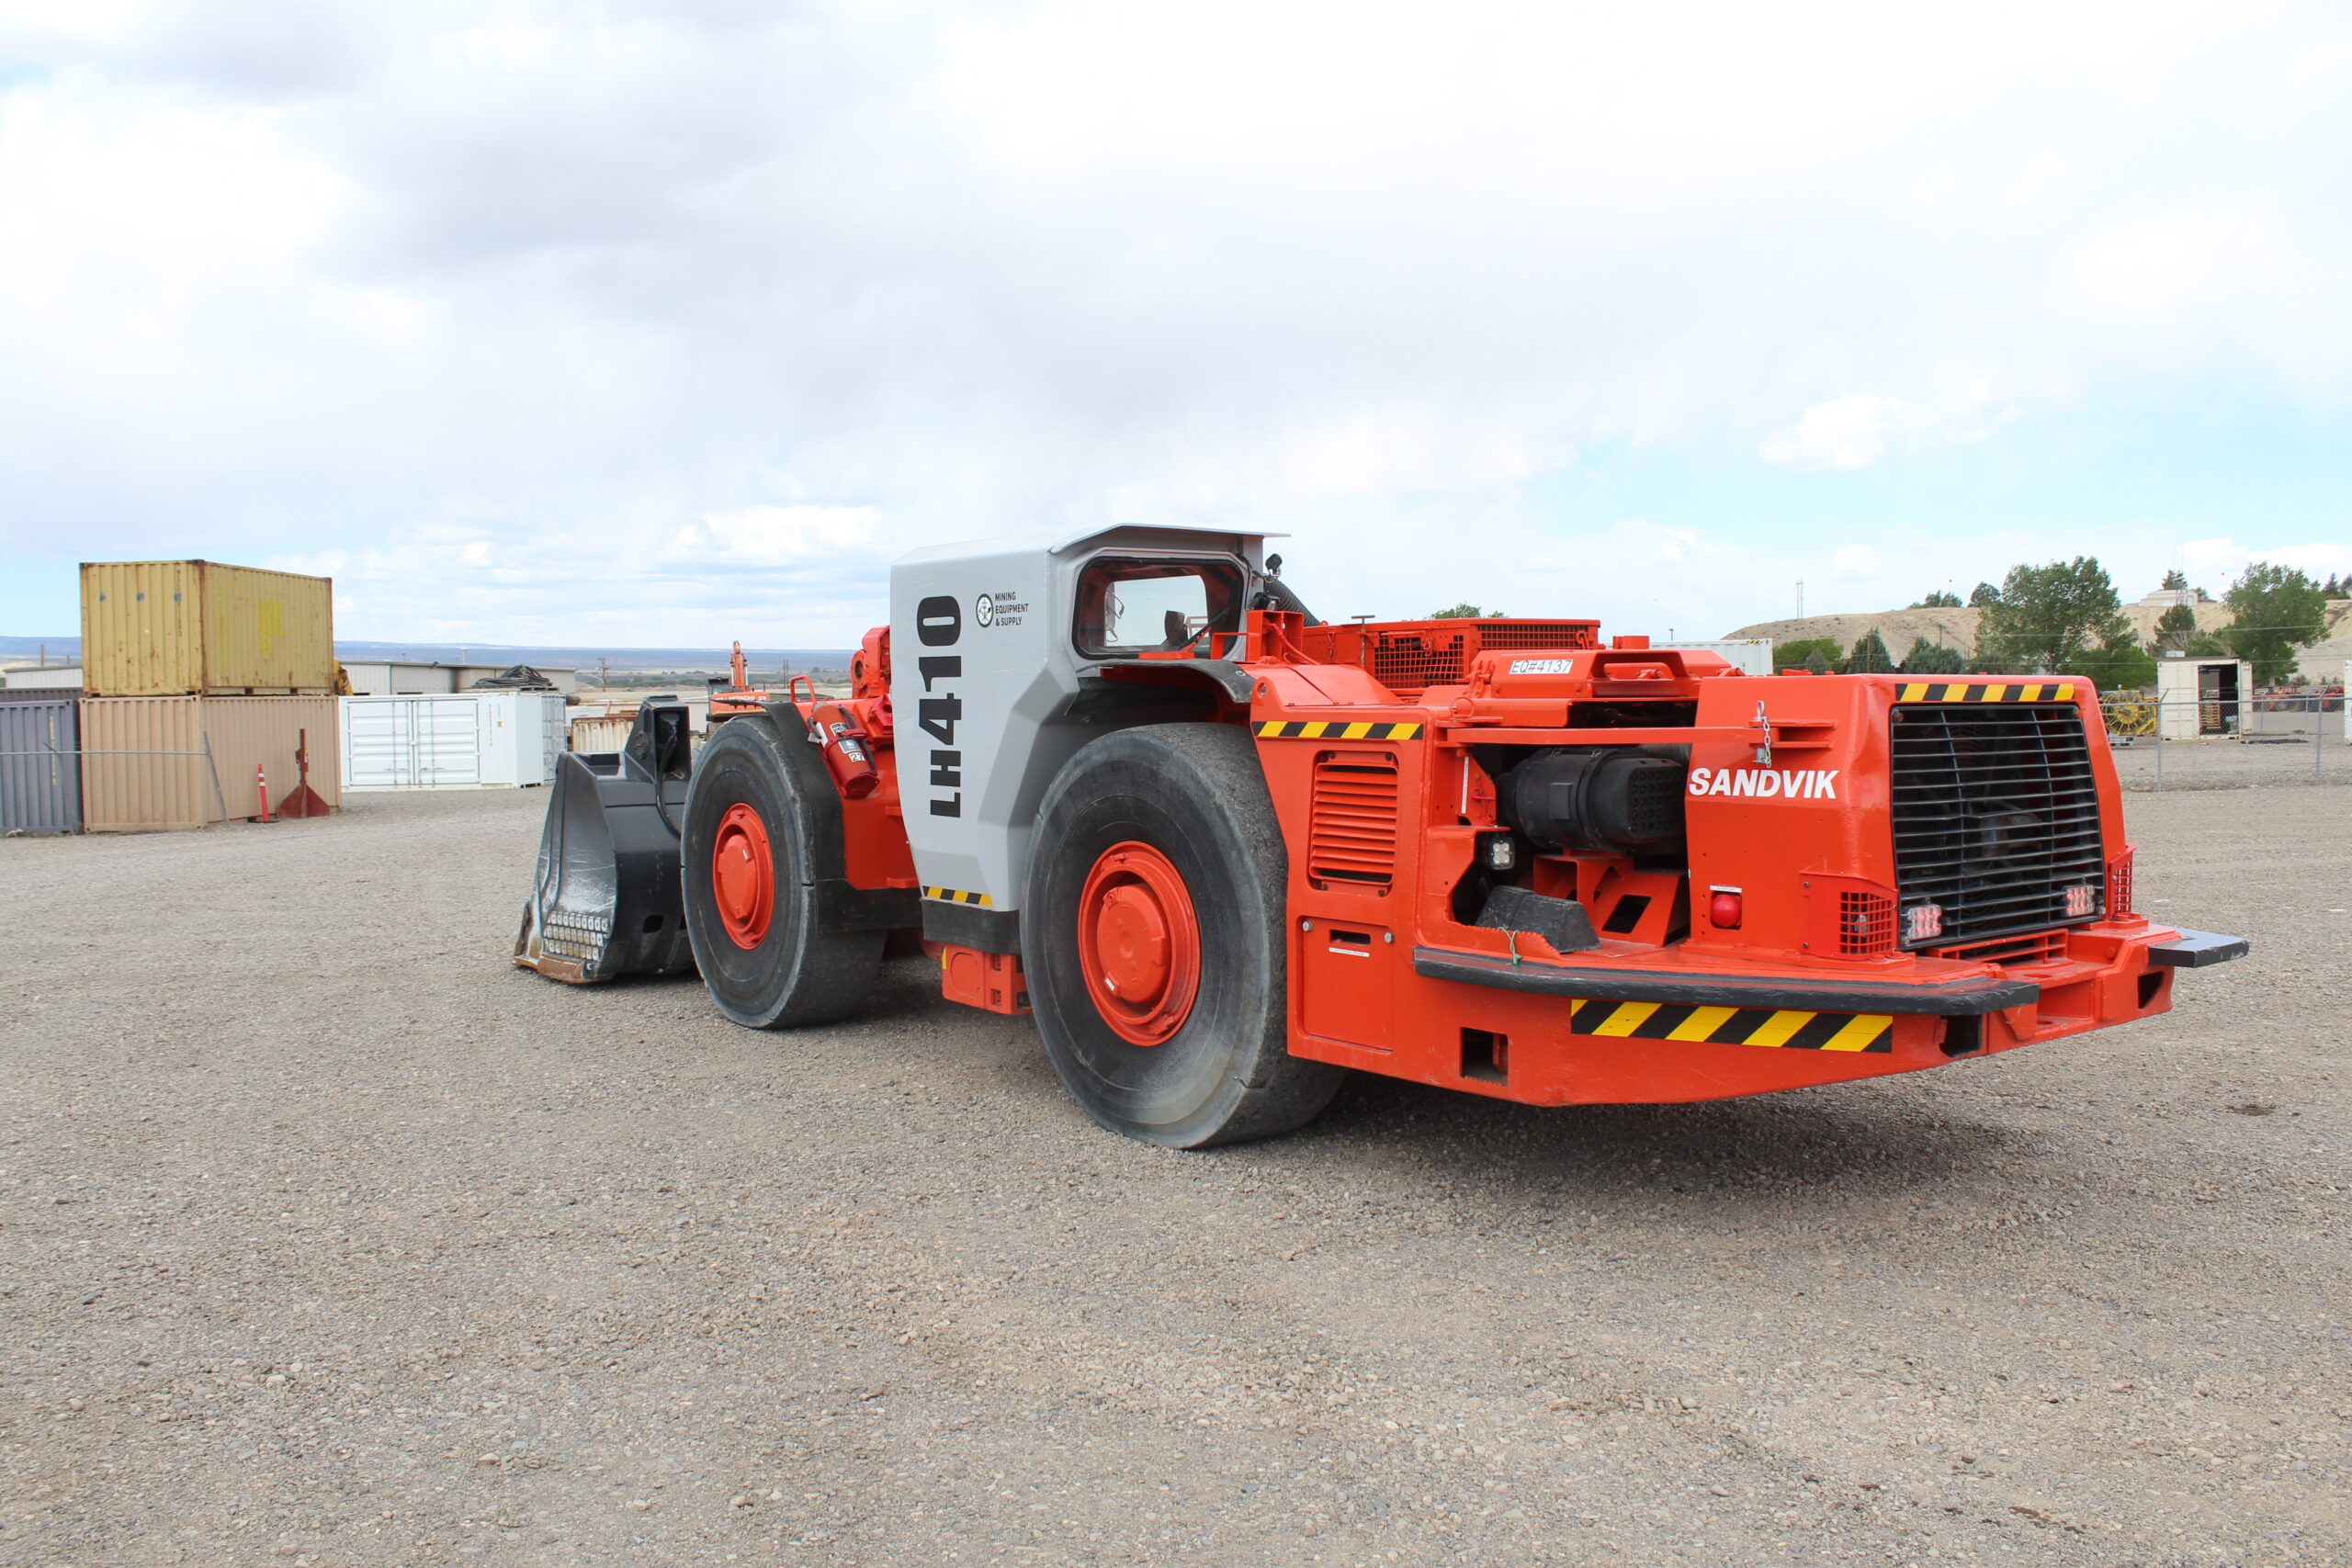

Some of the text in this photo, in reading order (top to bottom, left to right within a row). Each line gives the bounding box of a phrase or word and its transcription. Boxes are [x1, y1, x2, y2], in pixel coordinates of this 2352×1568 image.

[995, 592, 1016, 602] MINING
[995, 603, 1029, 614] EQUIPMENT
[995, 616, 1022, 626] & SUPPLY
[1511, 660, 1573, 673] EQ#4137
[917, 595, 962, 818] LH410
[1689, 767, 1840, 799] SANDVIK
